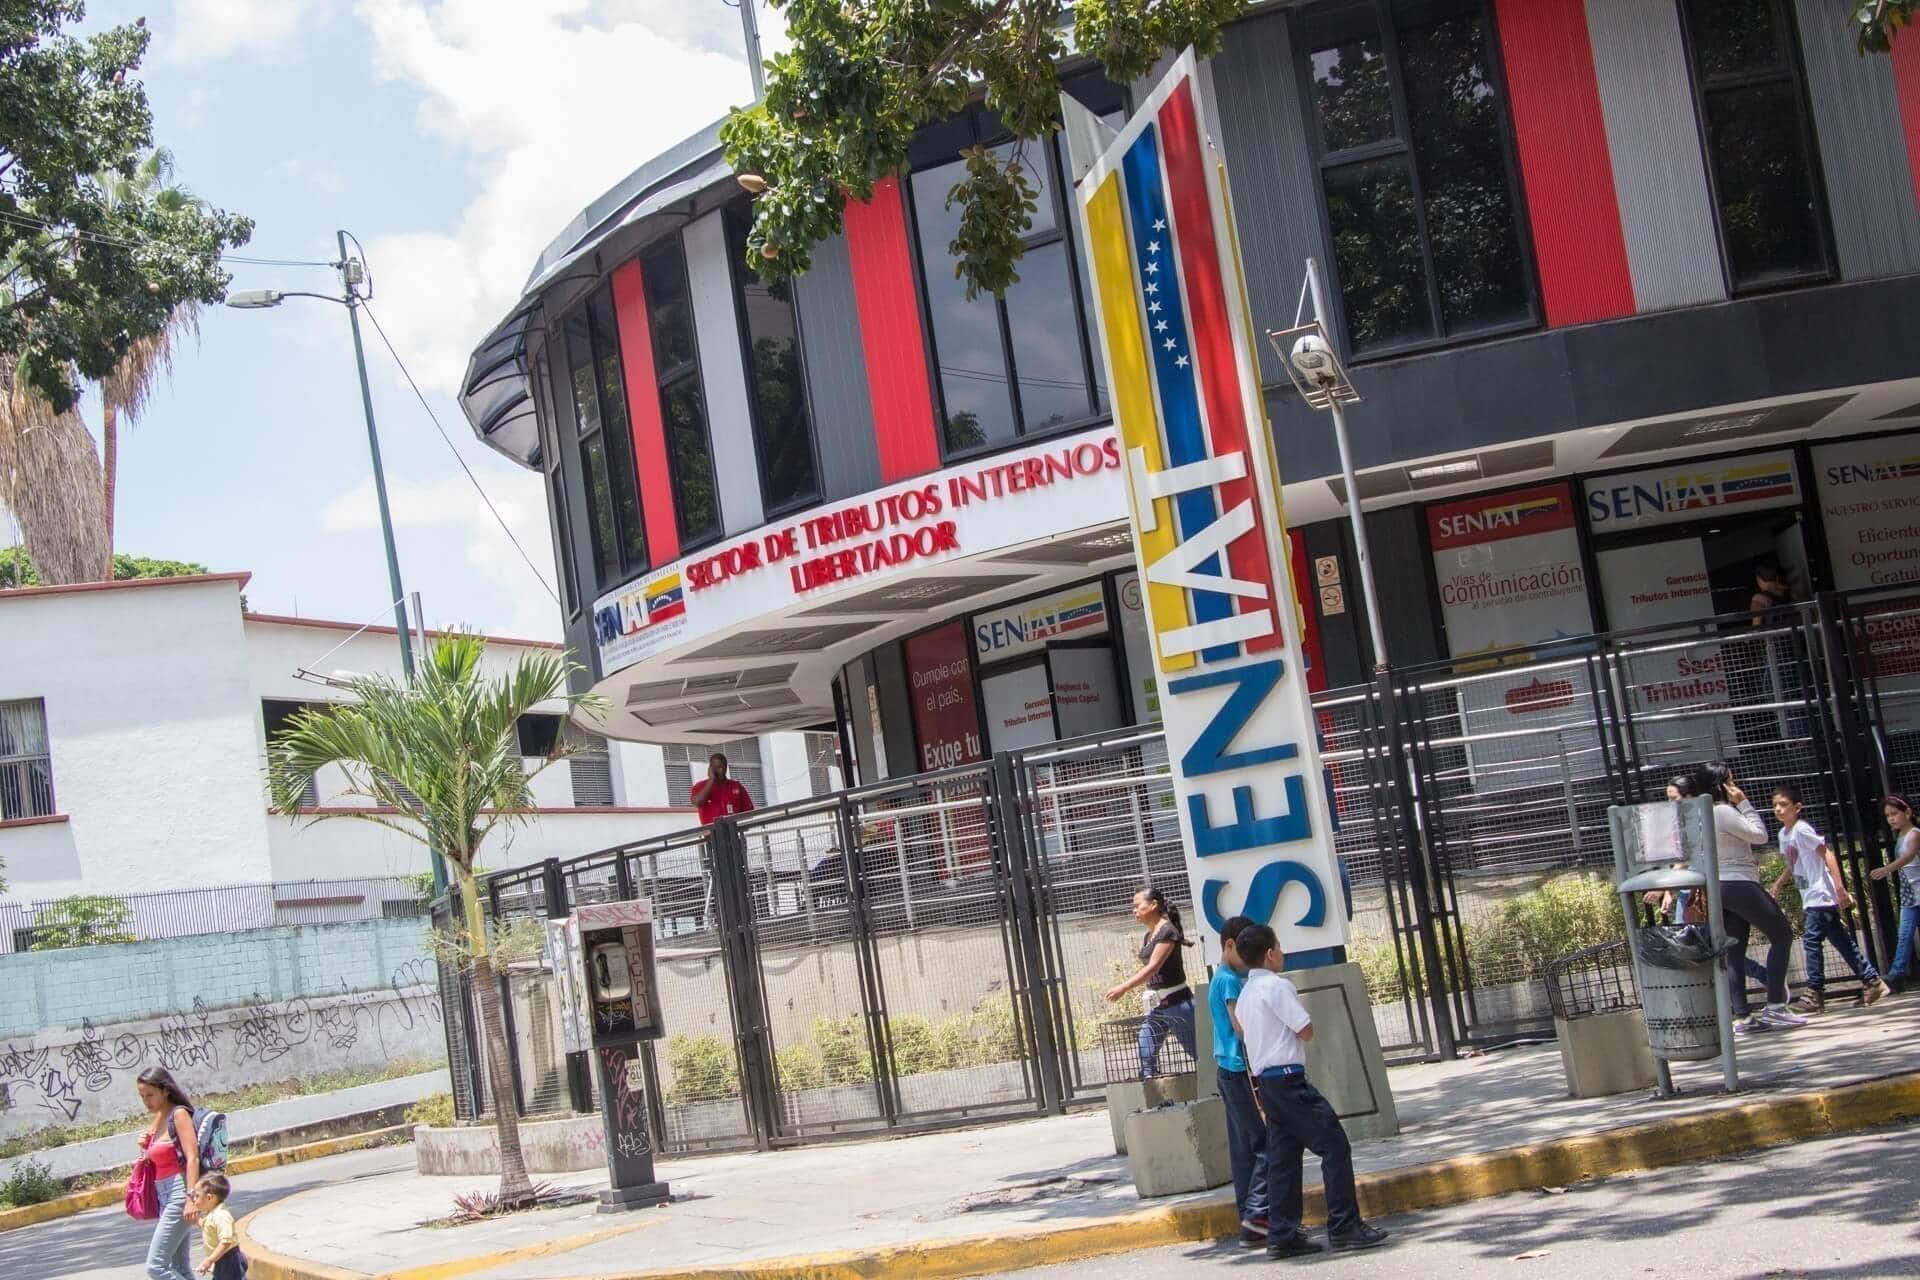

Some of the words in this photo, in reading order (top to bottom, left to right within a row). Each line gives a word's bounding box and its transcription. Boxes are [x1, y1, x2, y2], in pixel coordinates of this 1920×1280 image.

[686, 540, 763, 592] SECTOR
[764, 527, 801, 563] DE
[800, 484, 943, 549] TRIBUTOS
[948, 437, 1121, 508] INTERNOS
[1588, 474, 1729, 523] SENIAT
[1824, 501, 1879, 517] NUESTRO
[1438, 504, 1521, 538] SENIAT
[790, 520, 961, 594] LIBERTADOR
[1442, 564, 1583, 605] Comunicación
[1631, 592, 1669, 604] Tributos
[1670, 586, 1710, 599] Internos
[594, 592, 649, 647] SENIAT
[977, 605, 1063, 653] SENIAT
[912, 661, 949, 690] Cumple
[950, 656, 969, 678] con
[1128, 446, 1326, 935] SENIAT
[1641, 678, 1728, 704] Tributos
[926, 693, 940, 712] el
[1003, 716, 1027, 728] Tributos
[923, 740, 963, 770] Exige
[966, 733, 982, 757] tu
